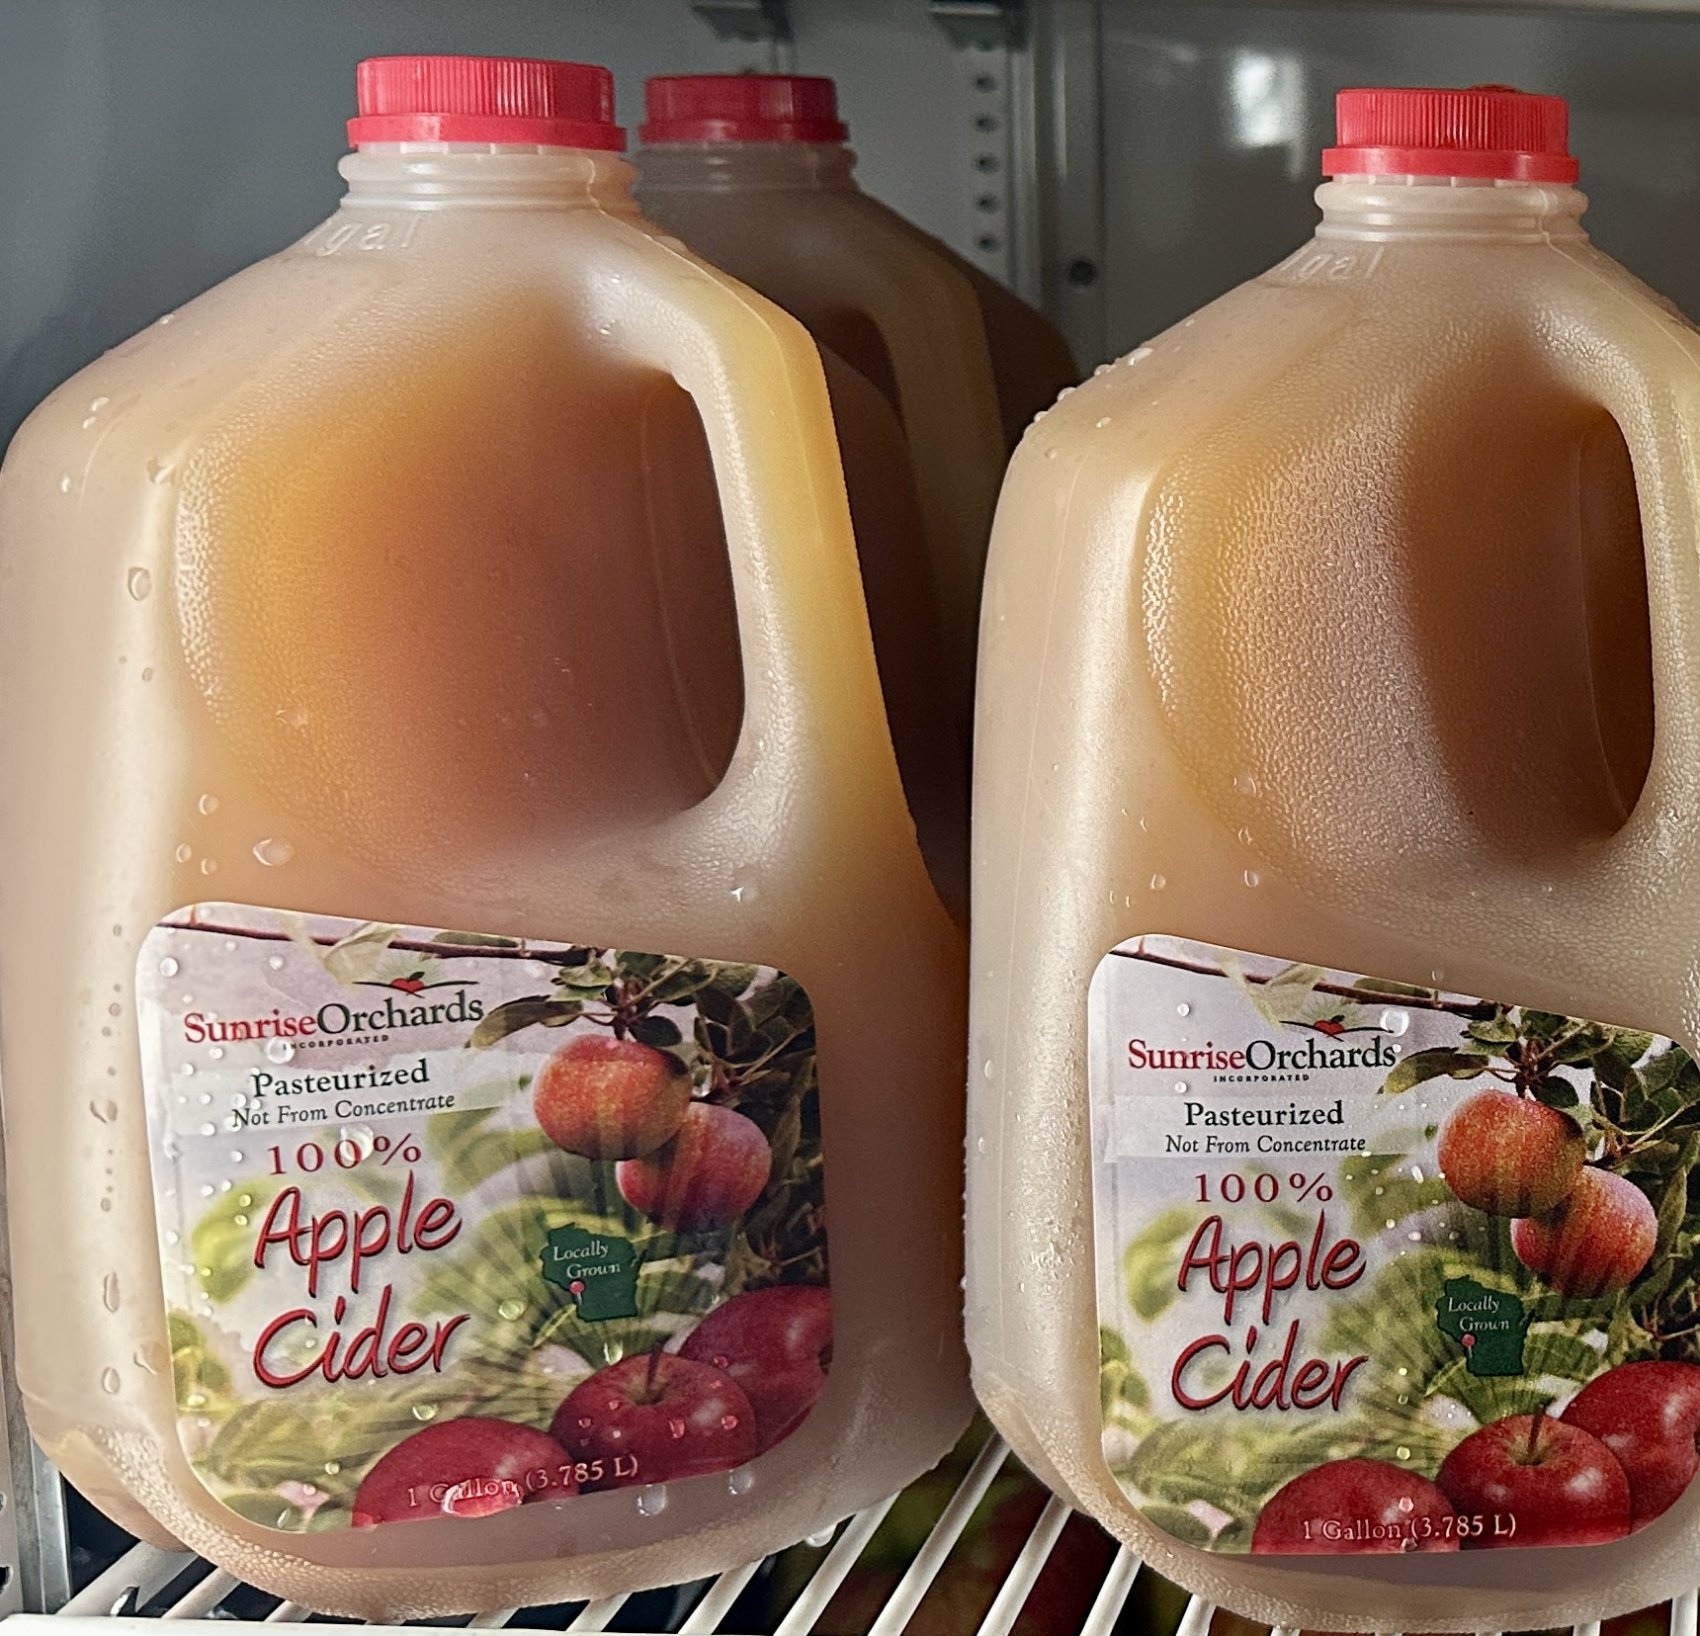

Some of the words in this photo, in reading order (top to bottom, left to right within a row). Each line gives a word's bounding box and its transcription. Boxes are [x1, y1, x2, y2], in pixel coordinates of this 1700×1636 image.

[184, 990, 484, 1043] SunriseOrchards
[1128, 1036, 1396, 1070] SunriseOrchards
[251, 1058, 430, 1098] Pasteurized
[1213, 1074, 1310, 1082] INCORPORATED
[233, 1108, 269, 1127] Not
[278, 1105, 328, 1124] From
[335, 1093, 456, 1119] Concentrate
[1184, 1101, 1344, 1126] Pasteurized
[267, 1132, 422, 1176] 100%
[1166, 1134, 1199, 1153] Not
[1205, 1134, 1250, 1153] From
[1257, 1133, 1366, 1153] Concentrate
[1194, 1171, 1334, 1203] 100%
[254, 1170, 462, 1296] Apple
[552, 1240, 609, 1263] Locally
[1177, 1208, 1367, 1325] Apple
[566, 1259, 620, 1279] Grown
[1448, 1296, 1500, 1316] Locally
[253, 1284, 471, 1389] Cider
[1459, 1315, 1509, 1333] Grown
[1171, 1319, 1368, 1412] Cider
[408, 1488, 416, 1506] 1
[429, 1480, 513, 1502] Gallon
[526, 1460, 603, 1491] (3.785
[614, 1455, 638, 1477] L)
[1303, 1521, 1310, 1540] 1
[1323, 1519, 1400, 1541] Gallon
[1408, 1517, 1484, 1540] (3.785
[1494, 1515, 1517, 1538] L)
